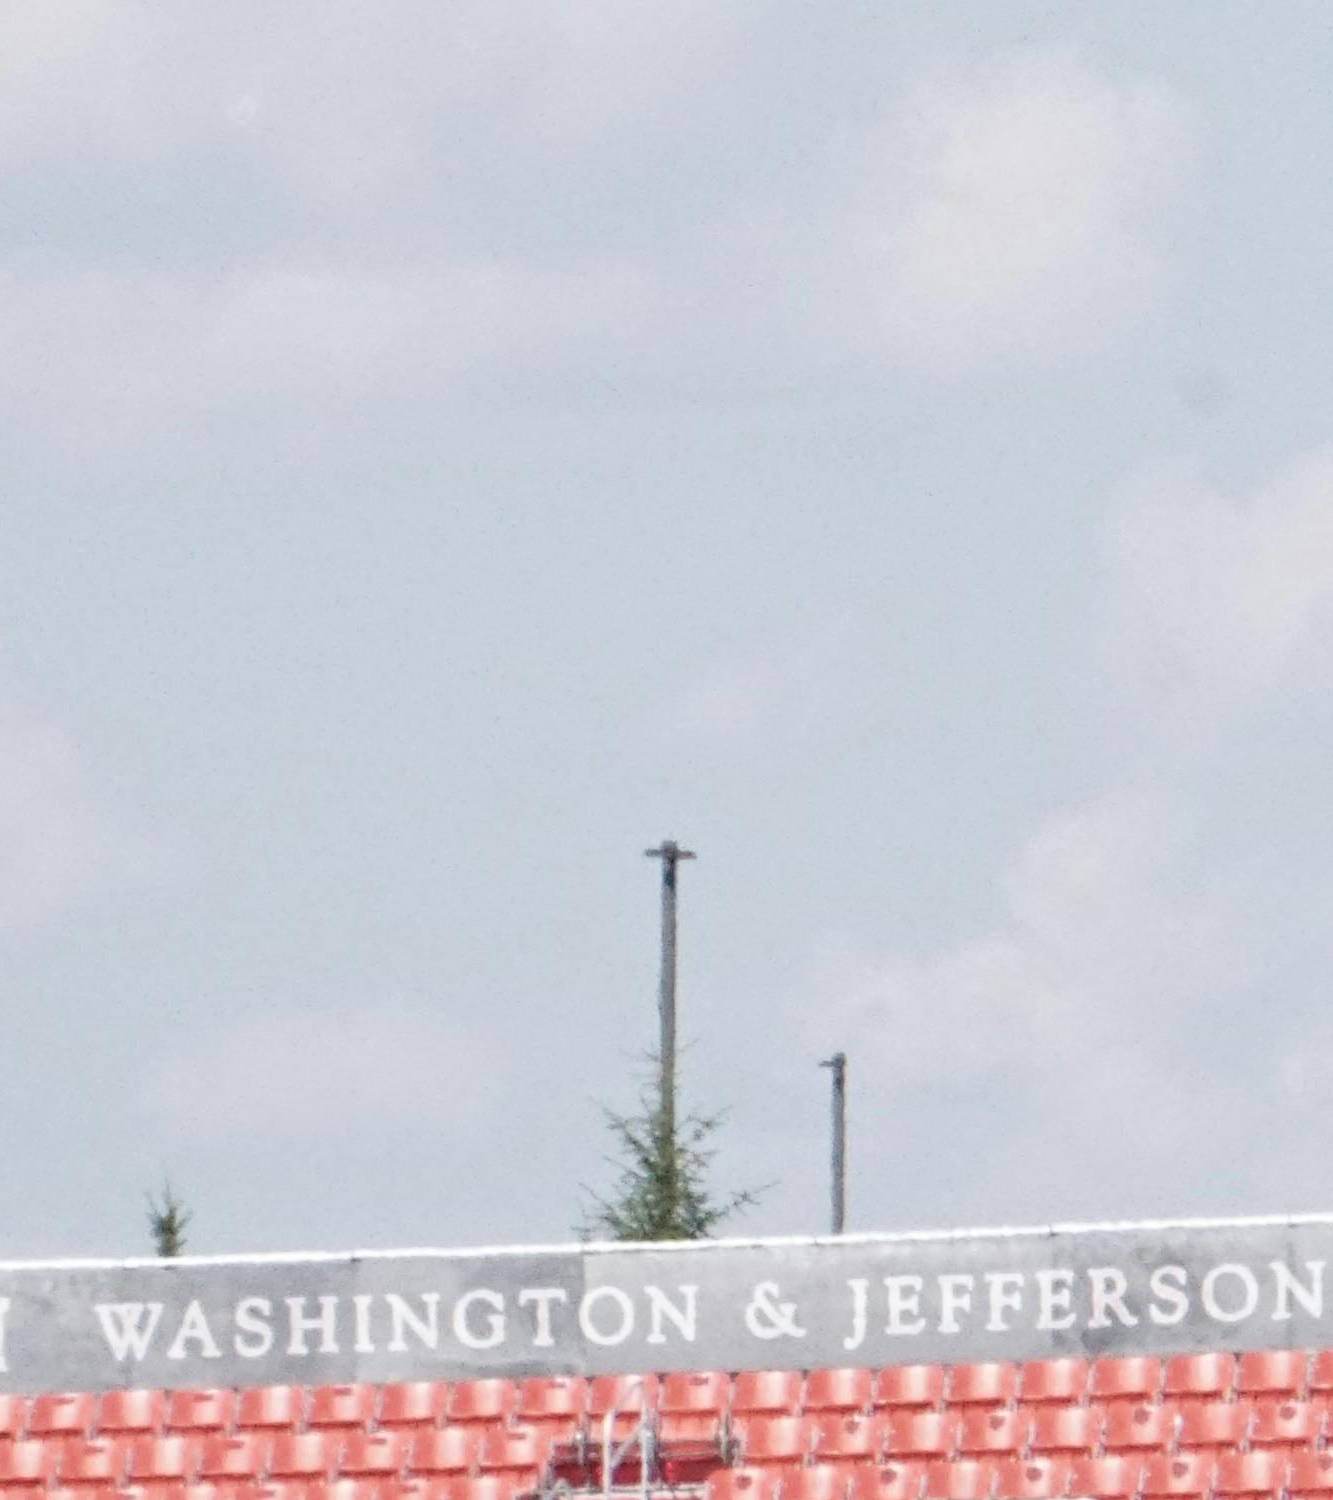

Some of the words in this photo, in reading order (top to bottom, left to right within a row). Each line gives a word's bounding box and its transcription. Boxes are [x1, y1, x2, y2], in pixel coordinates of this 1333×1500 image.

[94, 1284, 699, 1362] WASHINGTON
[745, 1281, 807, 1340] &
[843, 1260, 1327, 1350] JEFFERSON
